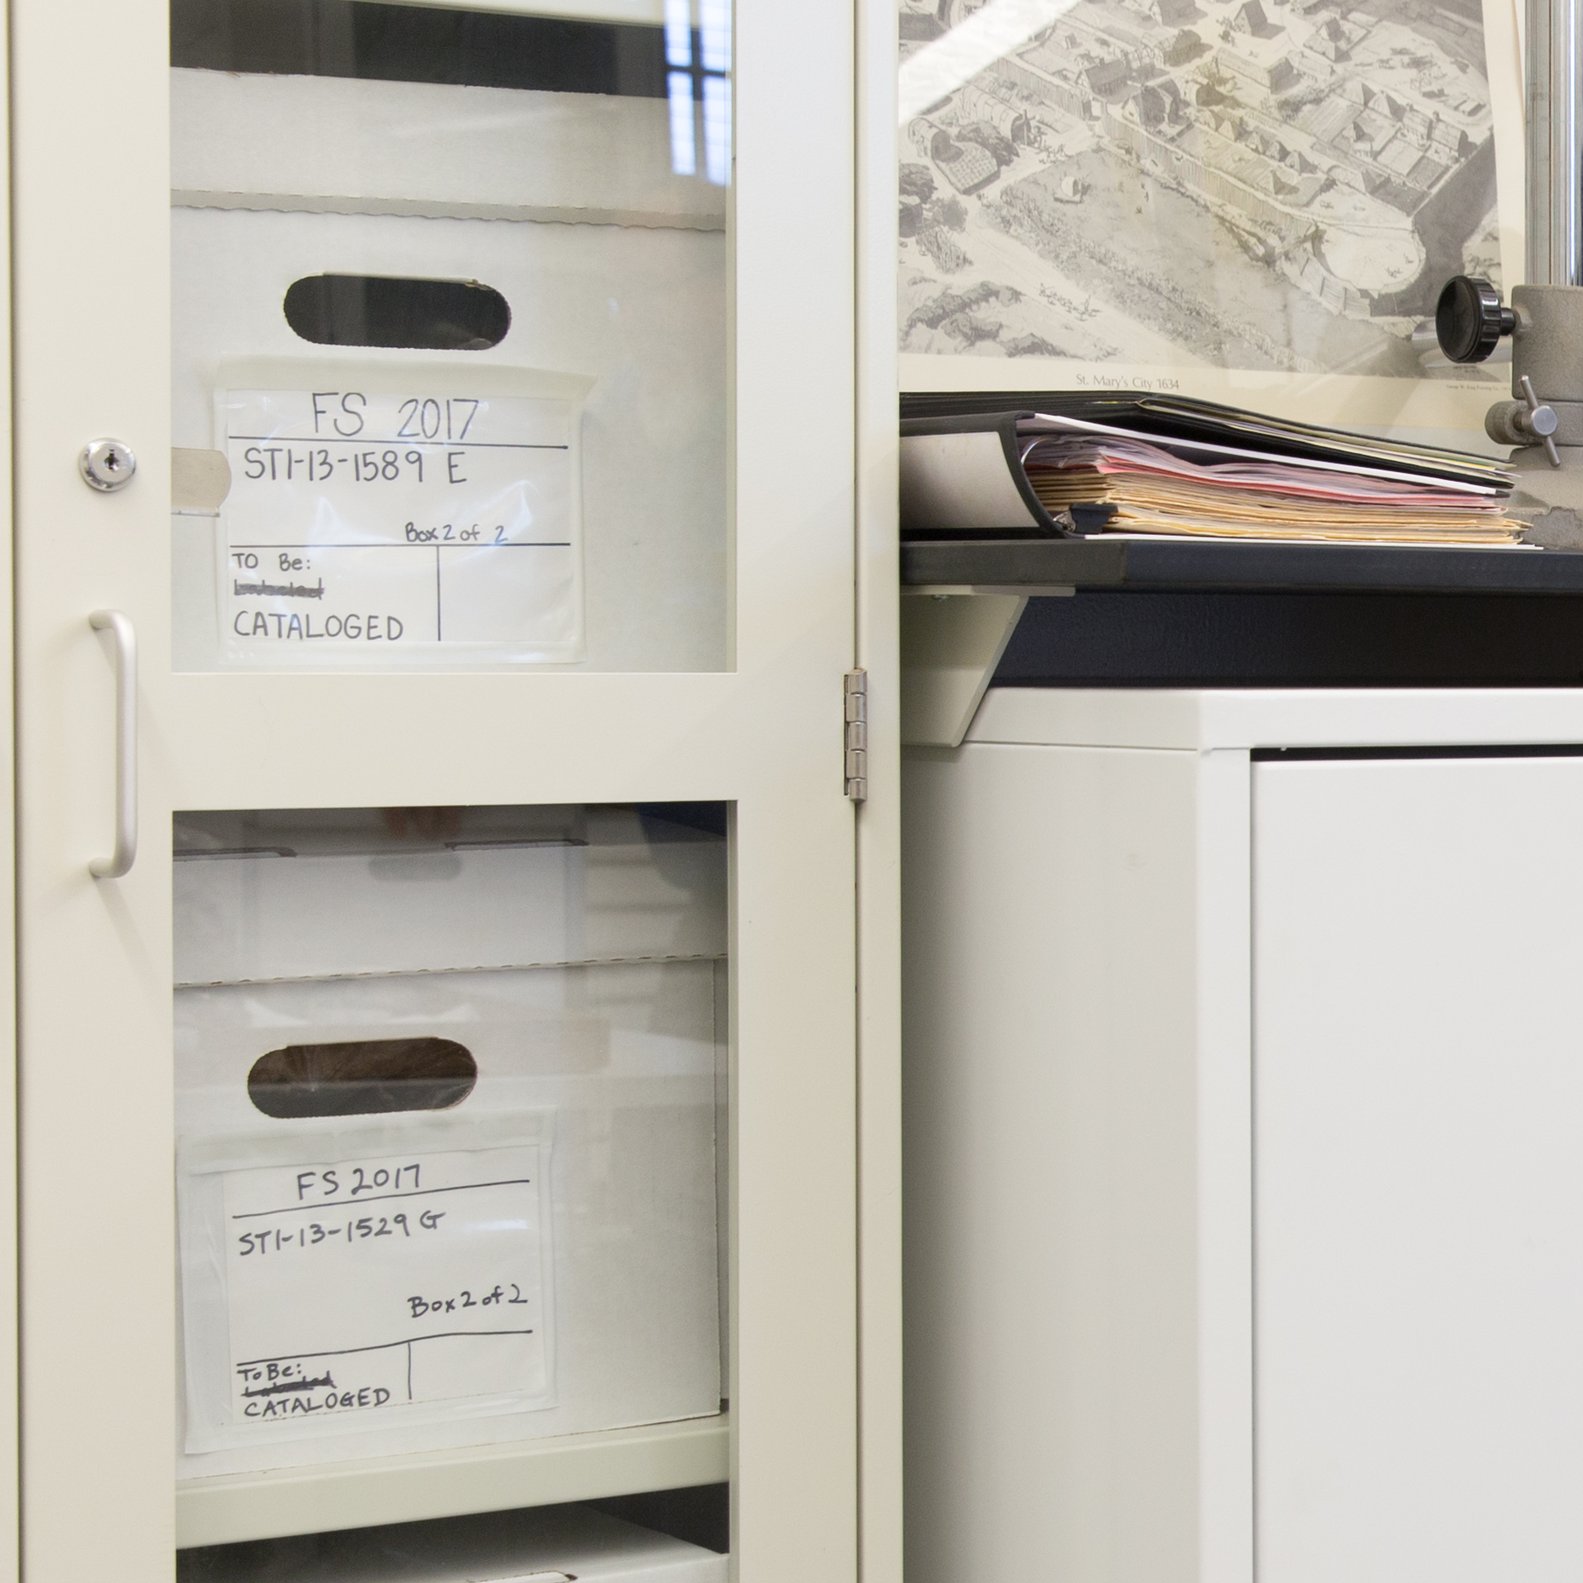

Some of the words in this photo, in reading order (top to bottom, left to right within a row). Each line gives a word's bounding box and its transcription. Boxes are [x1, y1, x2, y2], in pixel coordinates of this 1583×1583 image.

[1076, 373, 1089, 386] St.
[1093, 375, 1129, 389] Mary's
[1132, 376, 1152, 390] City
[1157, 378, 1180, 390] 1634
[311, 392, 367, 437] FS
[397, 398, 480, 440] 2017
[448, 451, 468, 484] E
[404, 522, 438, 544] Box
[441, 524, 457, 541] 2
[459, 523, 481, 542] of
[494, 525, 509, 544] 2
[233, 609, 405, 642] CATALOGED
[297, 1171, 340, 1201] FS
[351, 1163, 421, 1196] 2017
[419, 1209, 446, 1230] G
[407, 1295, 456, 1318] Box
[460, 1290, 476, 1308] 2
[481, 1285, 505, 1306] of
[508, 1283, 529, 1305] 2
[243, 1386, 391, 1418] CATALOGED
